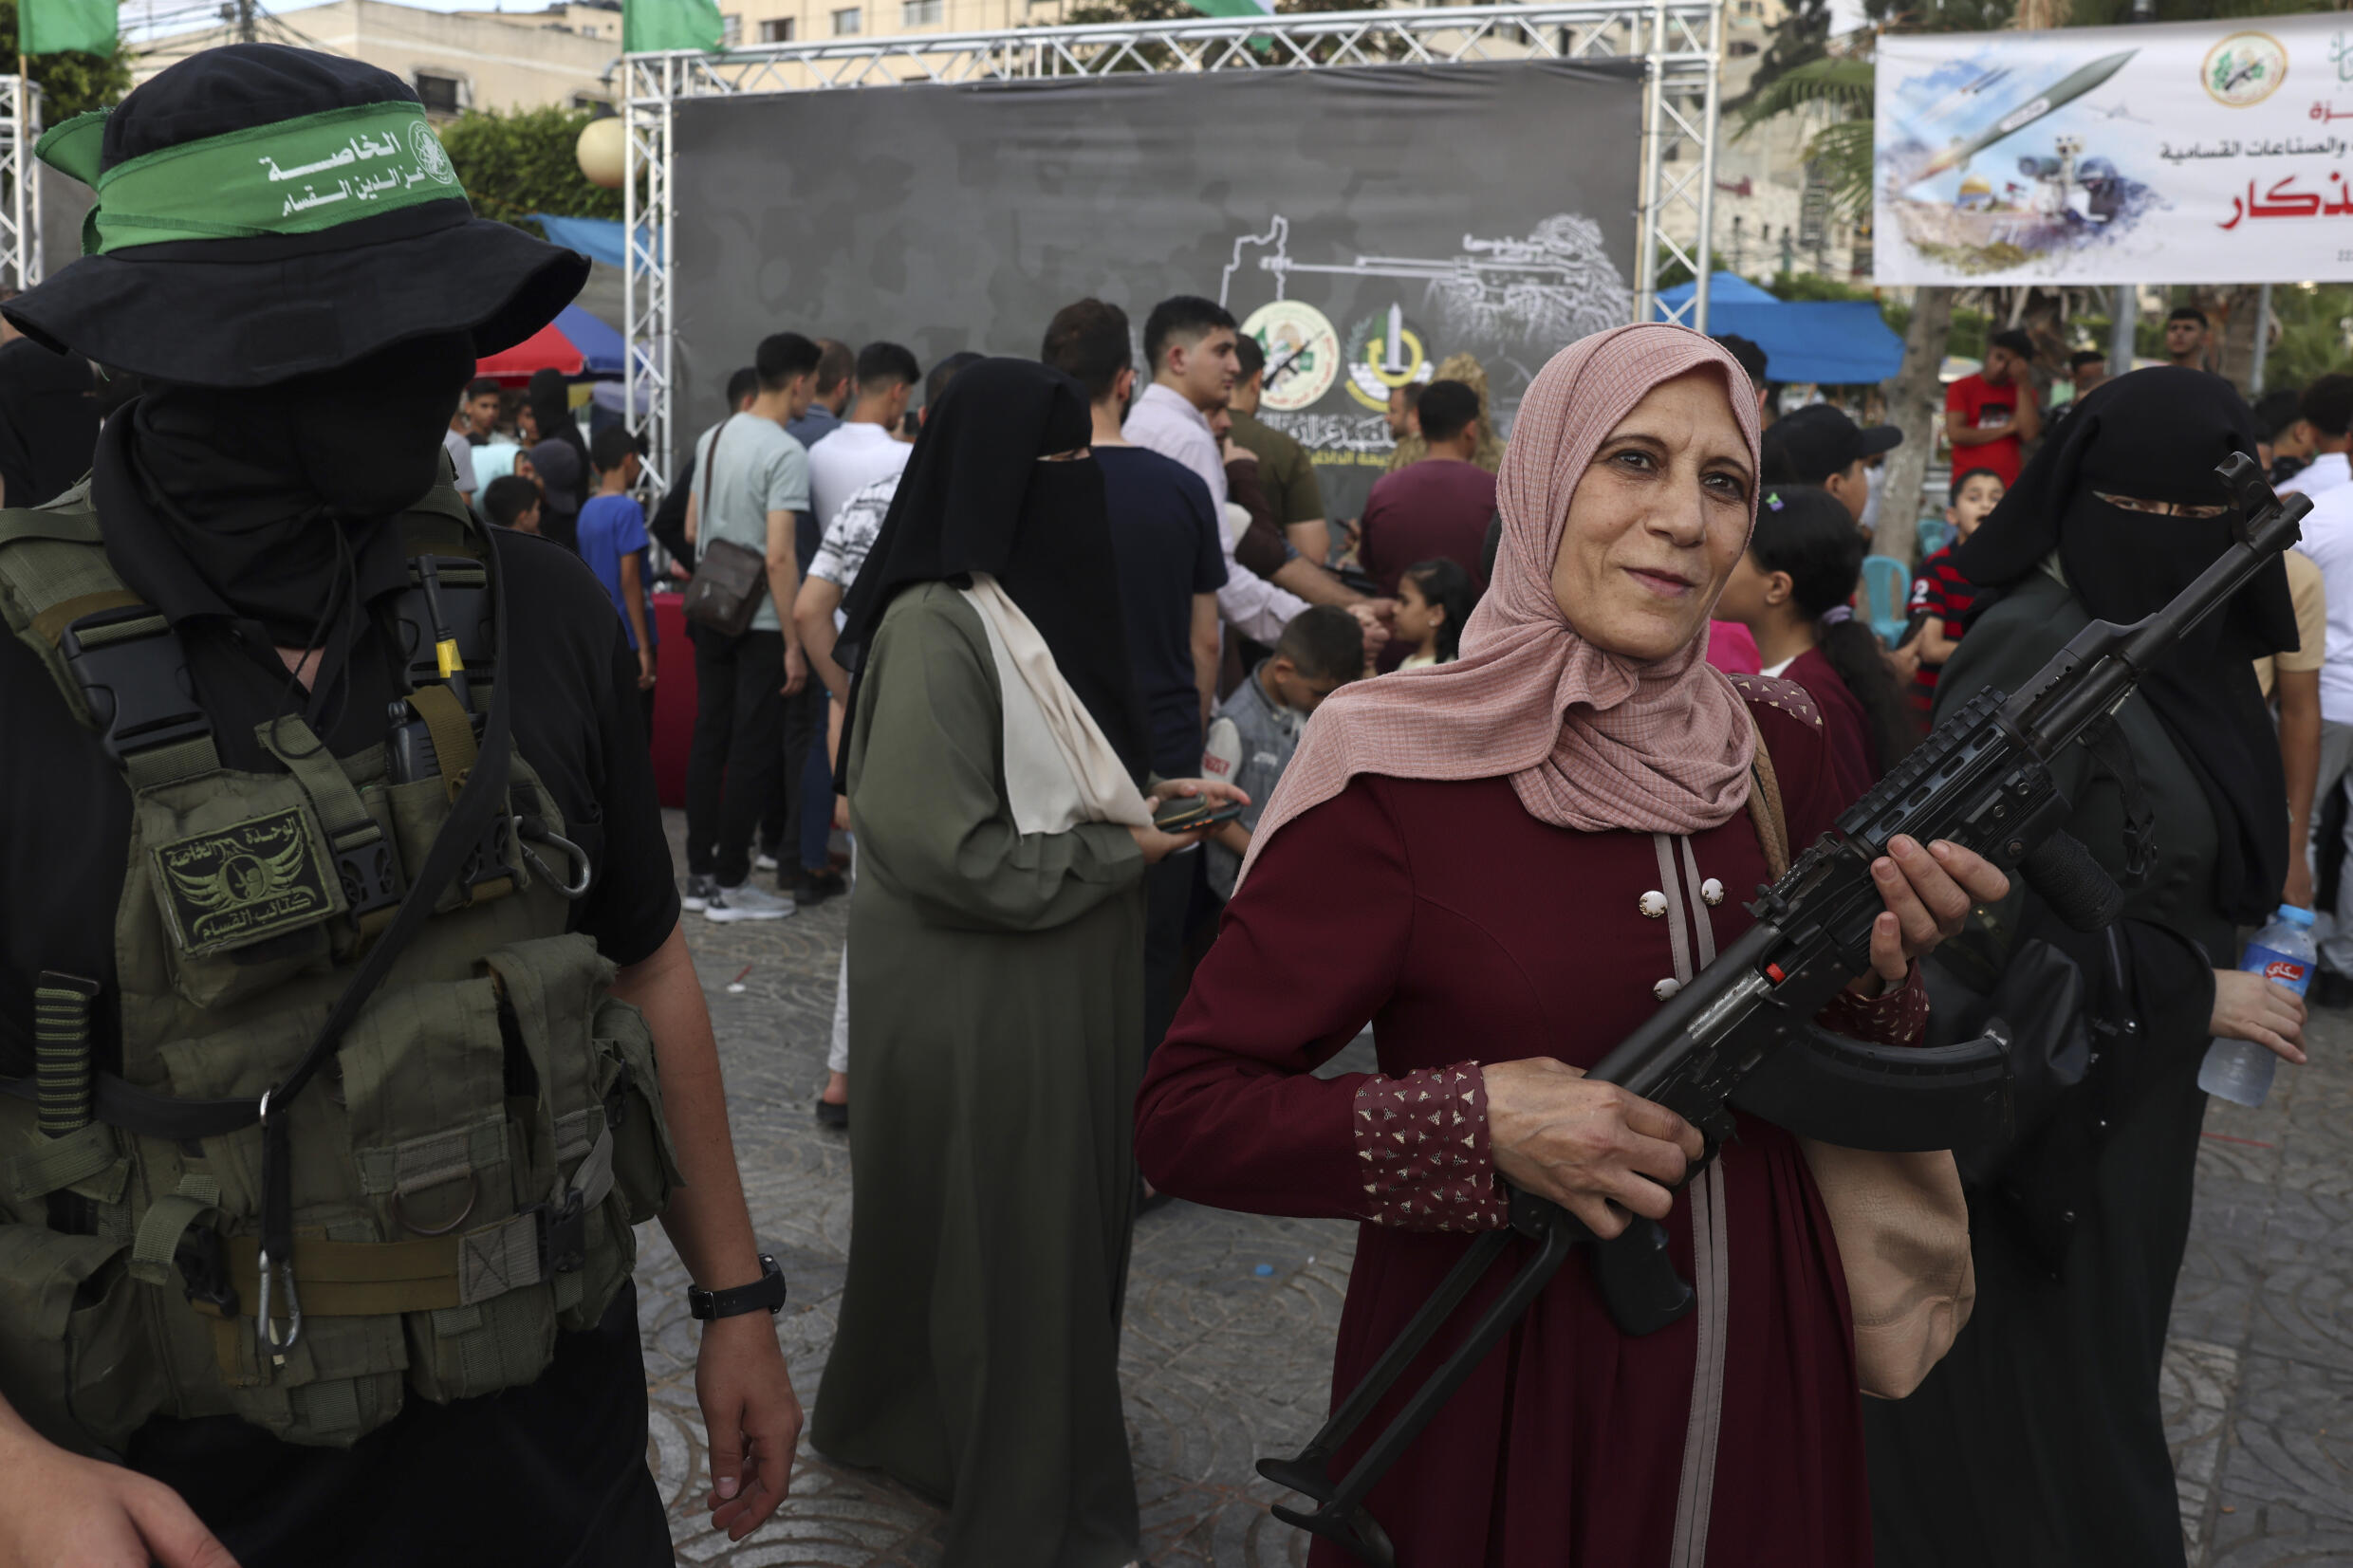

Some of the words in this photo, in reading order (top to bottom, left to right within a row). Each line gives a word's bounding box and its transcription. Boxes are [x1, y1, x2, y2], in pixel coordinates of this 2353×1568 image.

[258, 130, 402, 181] الخاصة
[2159, 141, 2241, 166] القسامية
[355, 167, 400, 200] الدين
[398, 164, 426, 190] عز
[282, 179, 353, 217] القسام
[202, 908, 253, 940] القسام
[255, 894, 311, 924] كتائب
